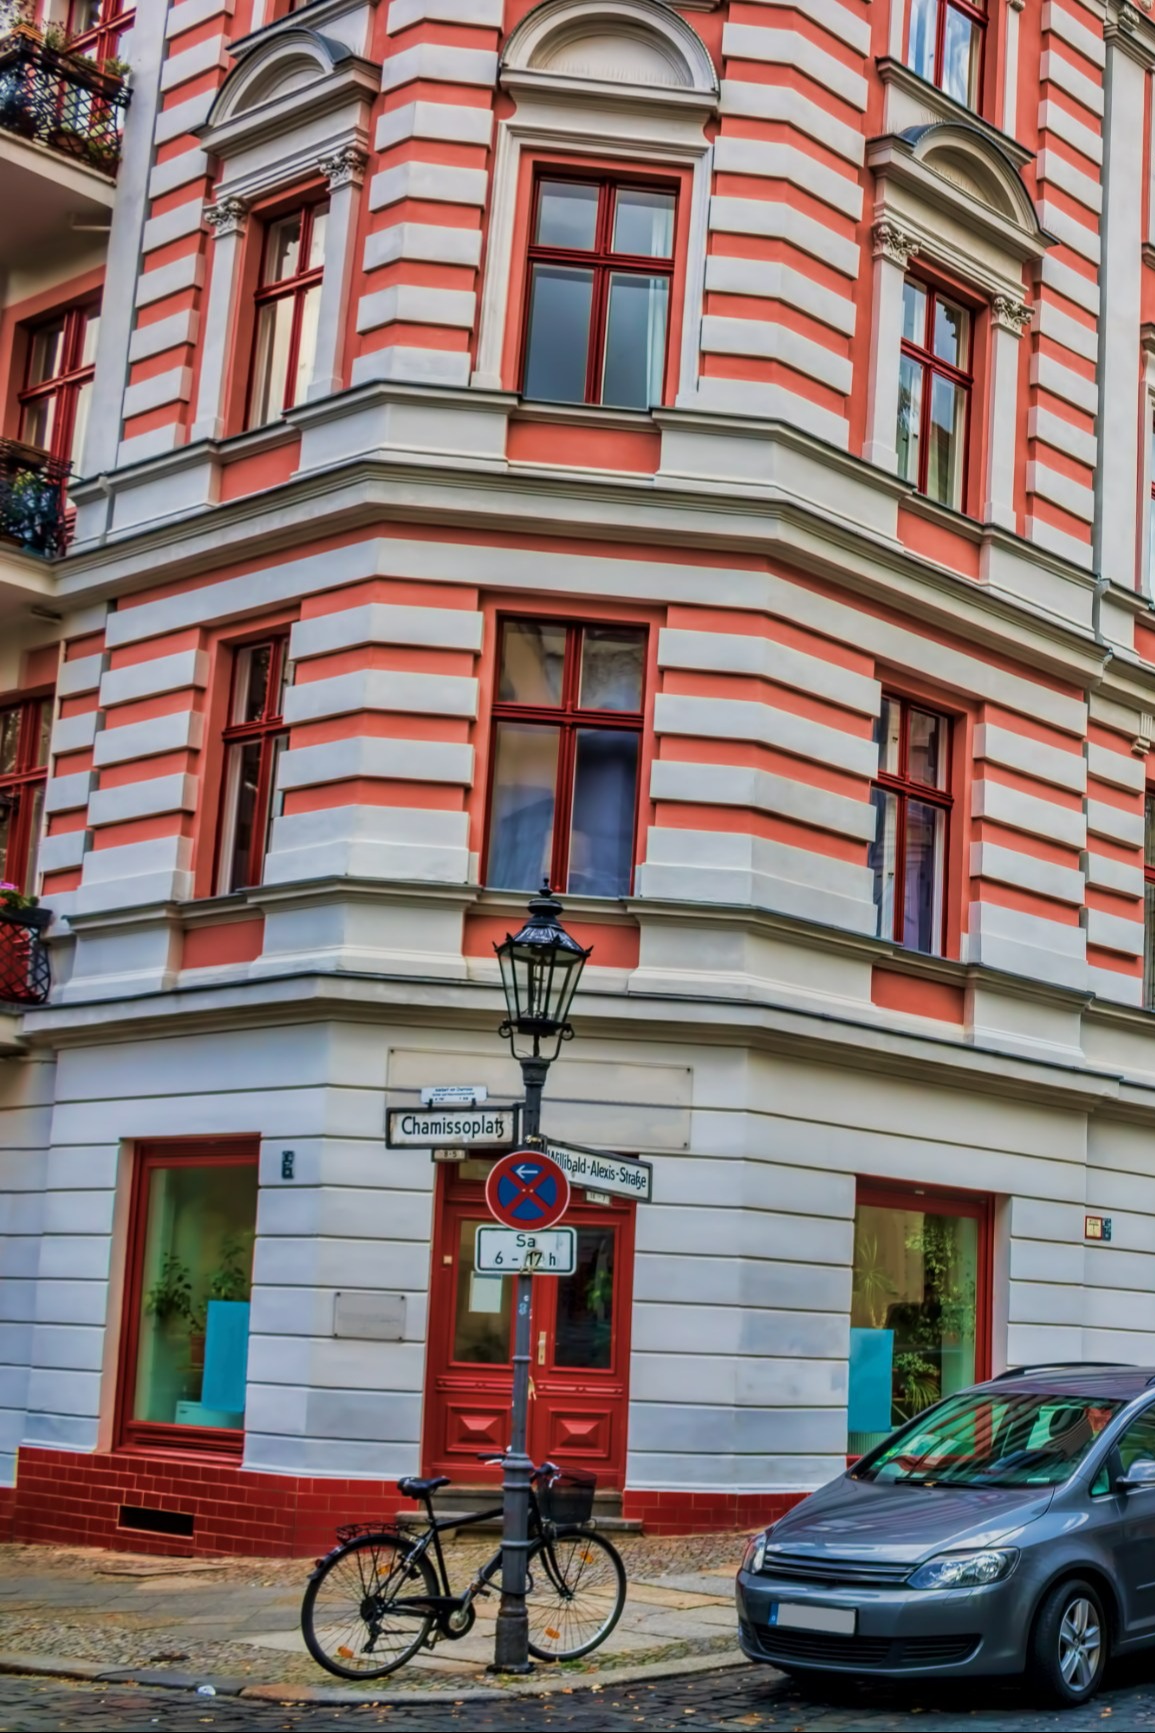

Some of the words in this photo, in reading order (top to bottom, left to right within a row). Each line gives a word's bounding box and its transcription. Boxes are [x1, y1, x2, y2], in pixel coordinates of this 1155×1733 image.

[401, 1115, 505, 1139] Chamissoplatz
[516, 1233, 536, 1248] Sa
[494, 1251, 504, 1265] 6
[549, 1252, 556, 1266] h
